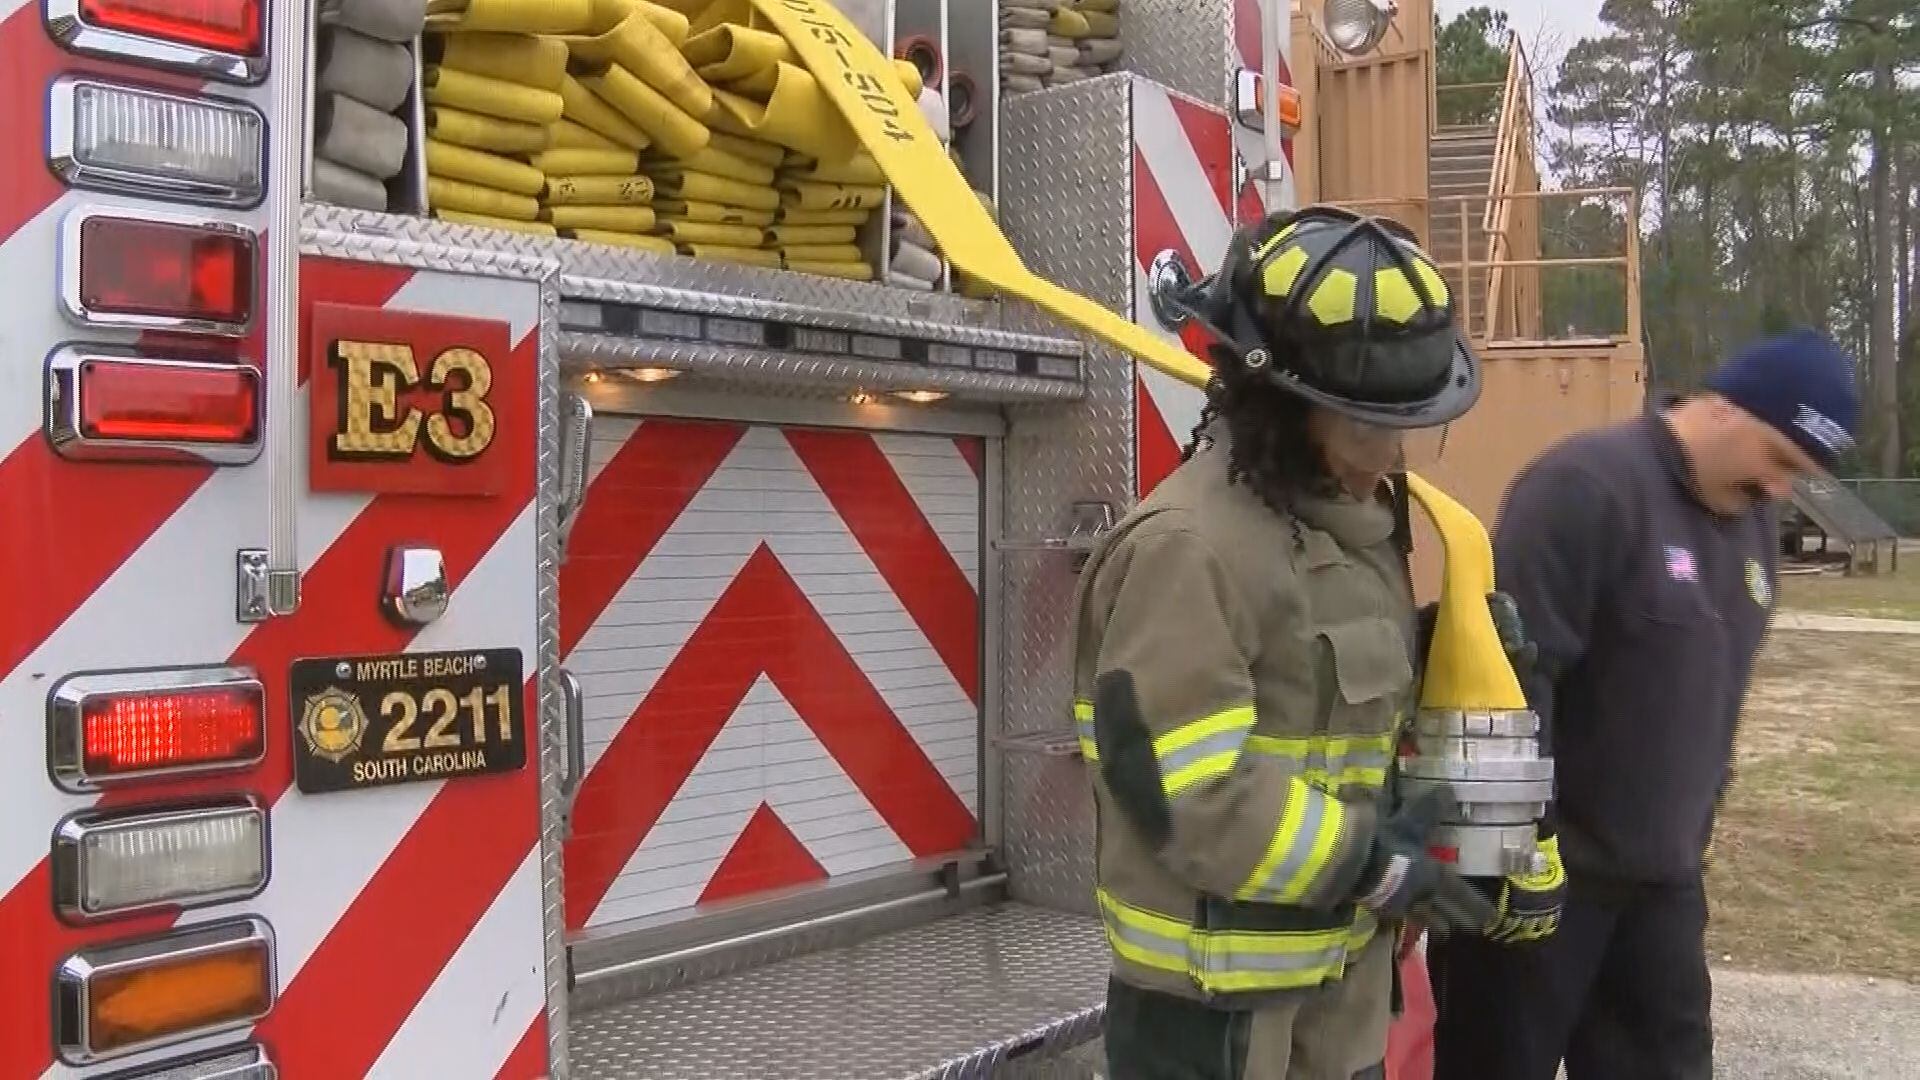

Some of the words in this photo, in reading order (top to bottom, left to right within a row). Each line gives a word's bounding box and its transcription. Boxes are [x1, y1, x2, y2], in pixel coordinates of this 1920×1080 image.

[328, 339, 497, 463] E3
[356, 658, 418, 681] MYRTLE
[423, 656, 473, 676] BEACH
[380, 684, 512, 752] 2211
[353, 758, 407, 782] SOUTH
[412, 750, 487, 774] CAROLINA
